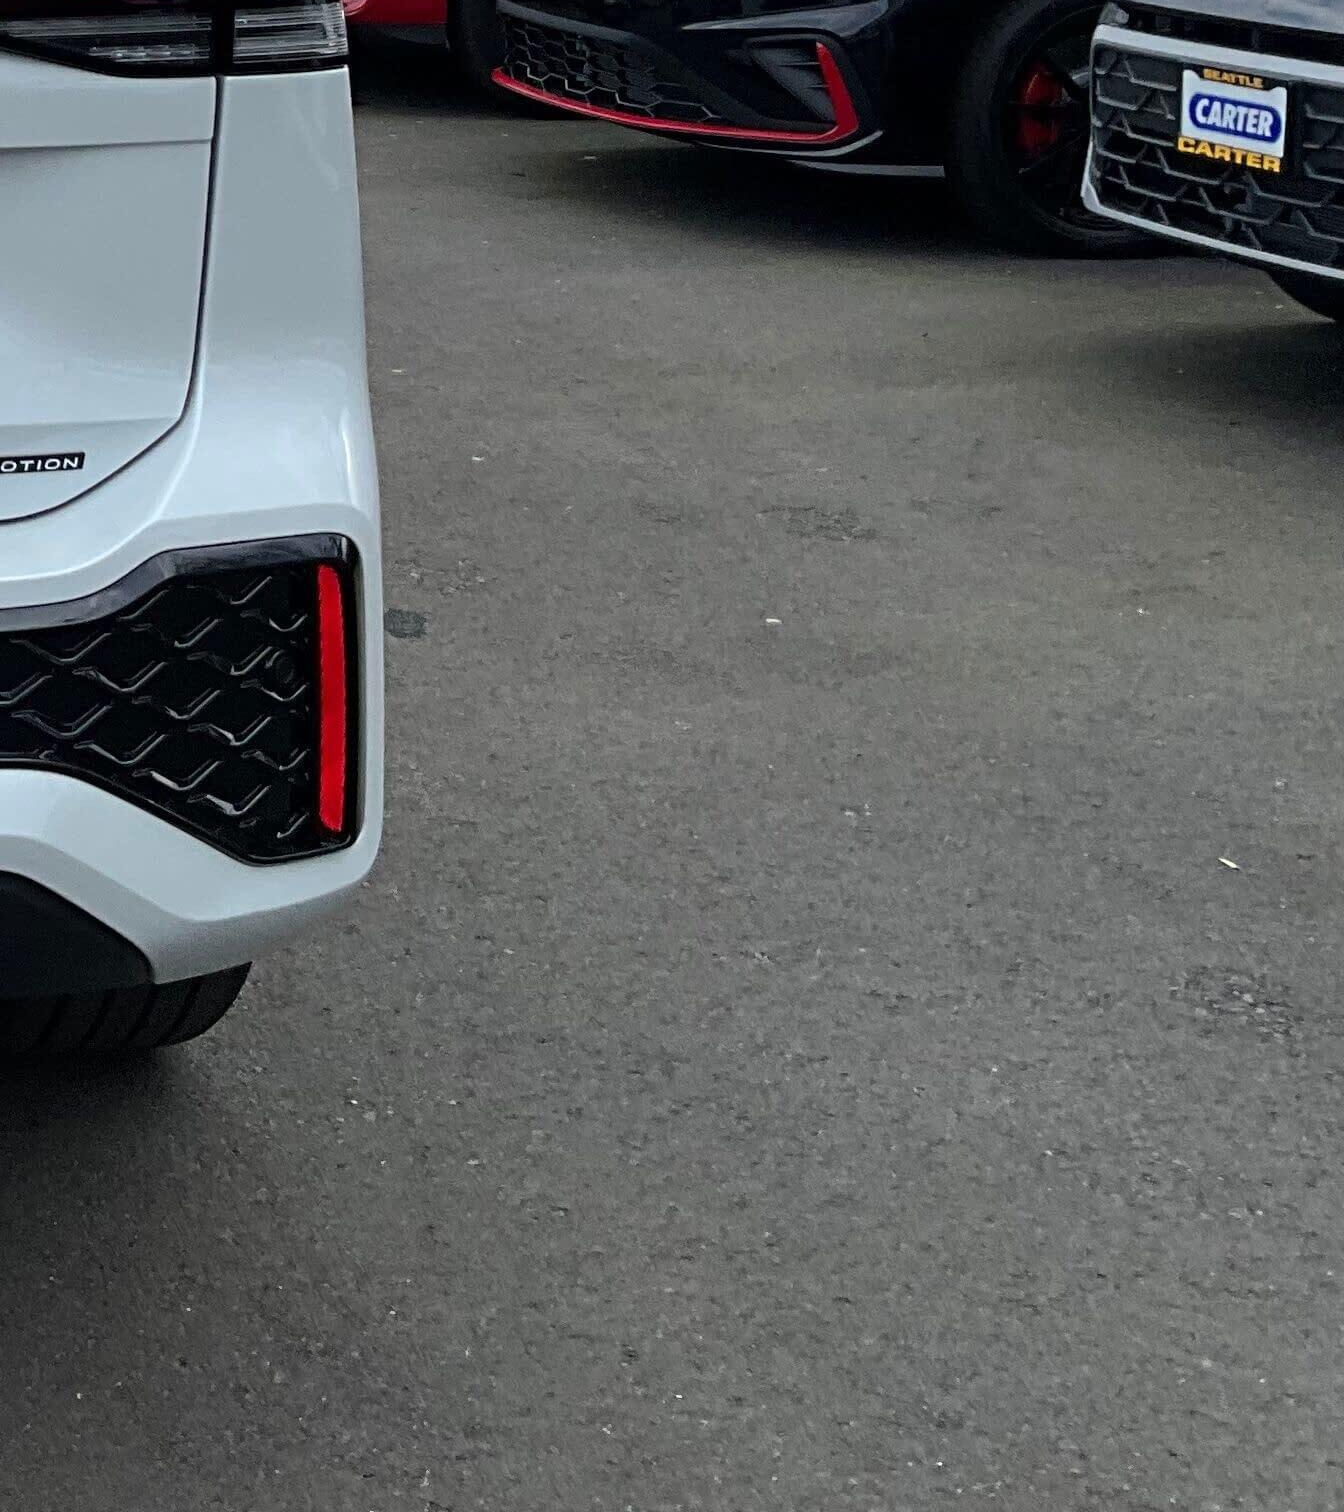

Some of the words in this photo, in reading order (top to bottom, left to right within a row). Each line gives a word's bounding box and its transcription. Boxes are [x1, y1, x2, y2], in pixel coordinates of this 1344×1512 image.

[1202, 68, 1263, 88] SEATTLE
[1195, 97, 1274, 137] CARTER
[1177, 136, 1281, 173] CARTER
